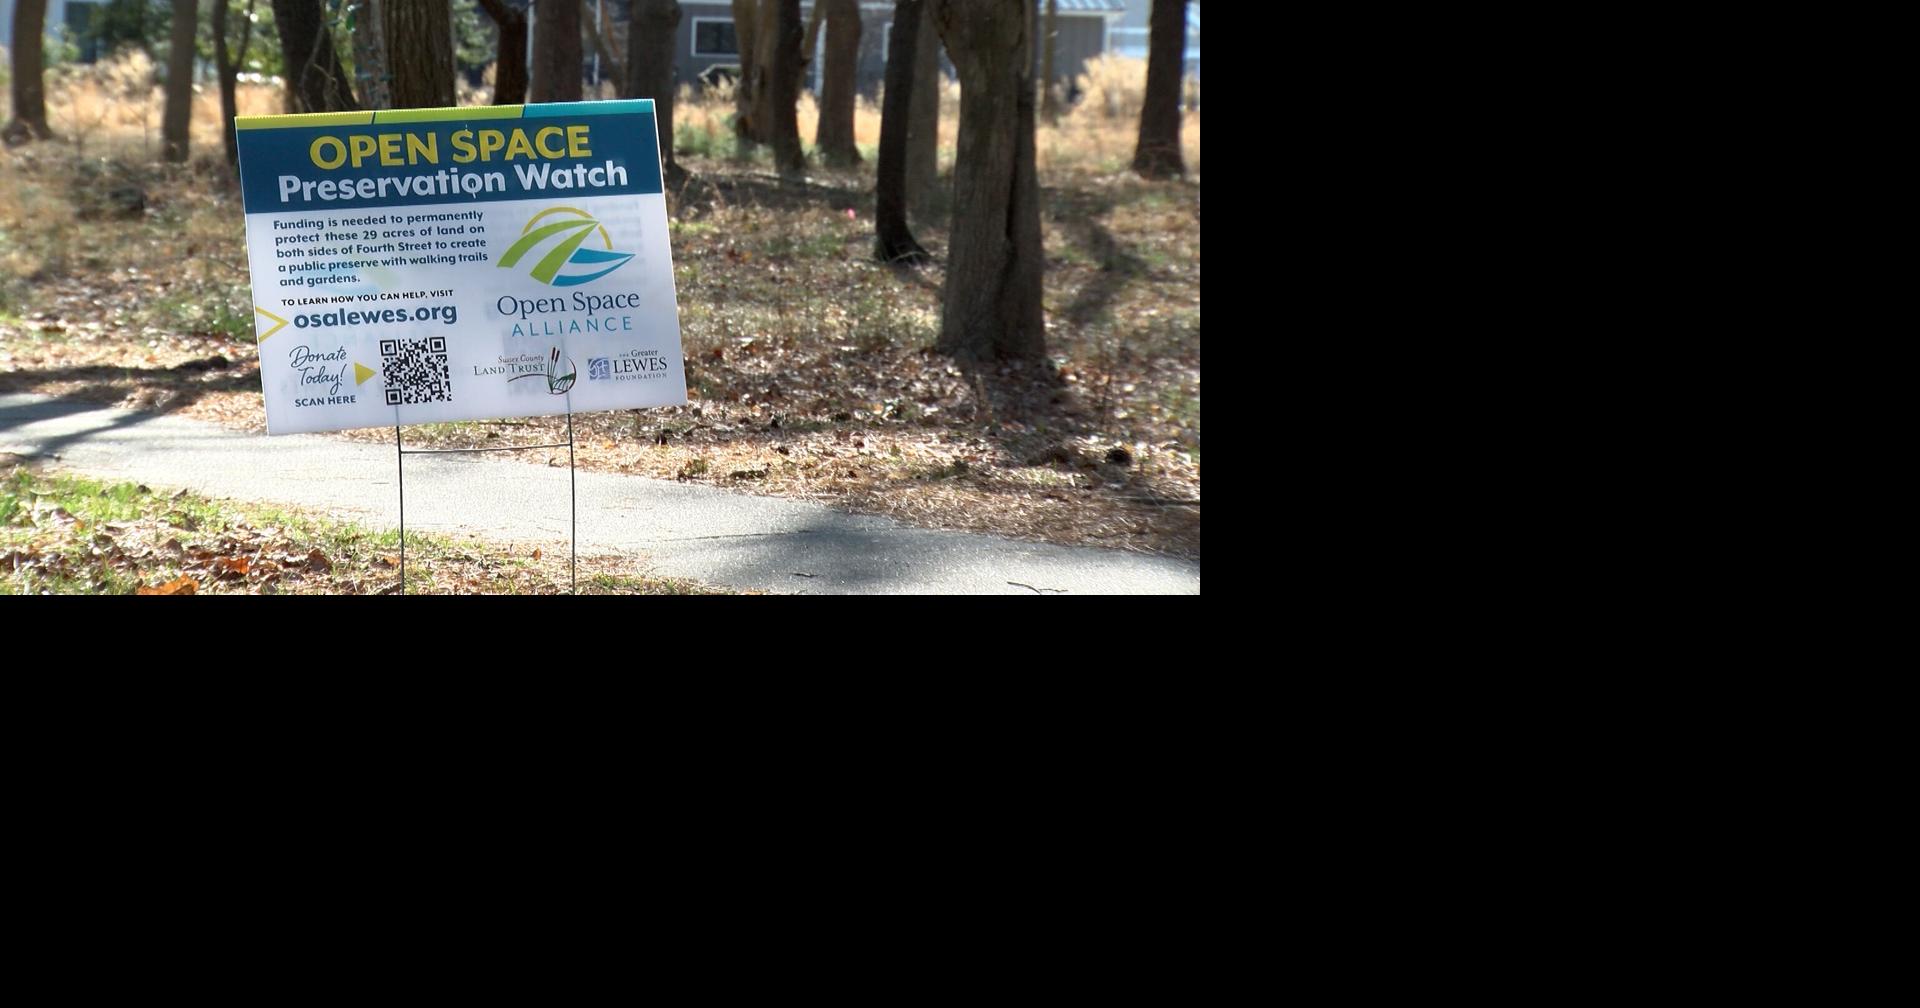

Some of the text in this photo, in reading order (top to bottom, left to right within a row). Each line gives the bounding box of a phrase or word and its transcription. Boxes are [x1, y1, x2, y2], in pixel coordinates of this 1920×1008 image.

[310, 125, 592, 170] OPEN SPACE
[279, 160, 628, 202] Preservation Watch
[274, 211, 483, 230] Funding is needed to permanently
[275, 225, 485, 246] protect these 29 acres of land on
[277, 239, 486, 258] both sides of Fourth Street to create
[278, 252, 488, 274] a public preserve with walking trails
[280, 274, 360, 288] and gardens.
[298, 297, 328, 305] LEARN
[380, 292, 400, 300] CAN
[402, 291, 427, 299] HELP,
[497, 291, 640, 319] Open Space
[294, 305, 457, 328] osalewes.org
[512, 316, 632, 337] ALLIANCE
[289, 345, 347, 368] Donate
[520, 354, 544, 362] County
[631, 349, 658, 357] Greater
[474, 363, 545, 375] LAND TRUST
[613, 357, 667, 374] LEWES
[298, 364, 347, 395] Today!
[615, 373, 667, 381] FOUNDATION
[295, 395, 356, 407] SCAN HERE
